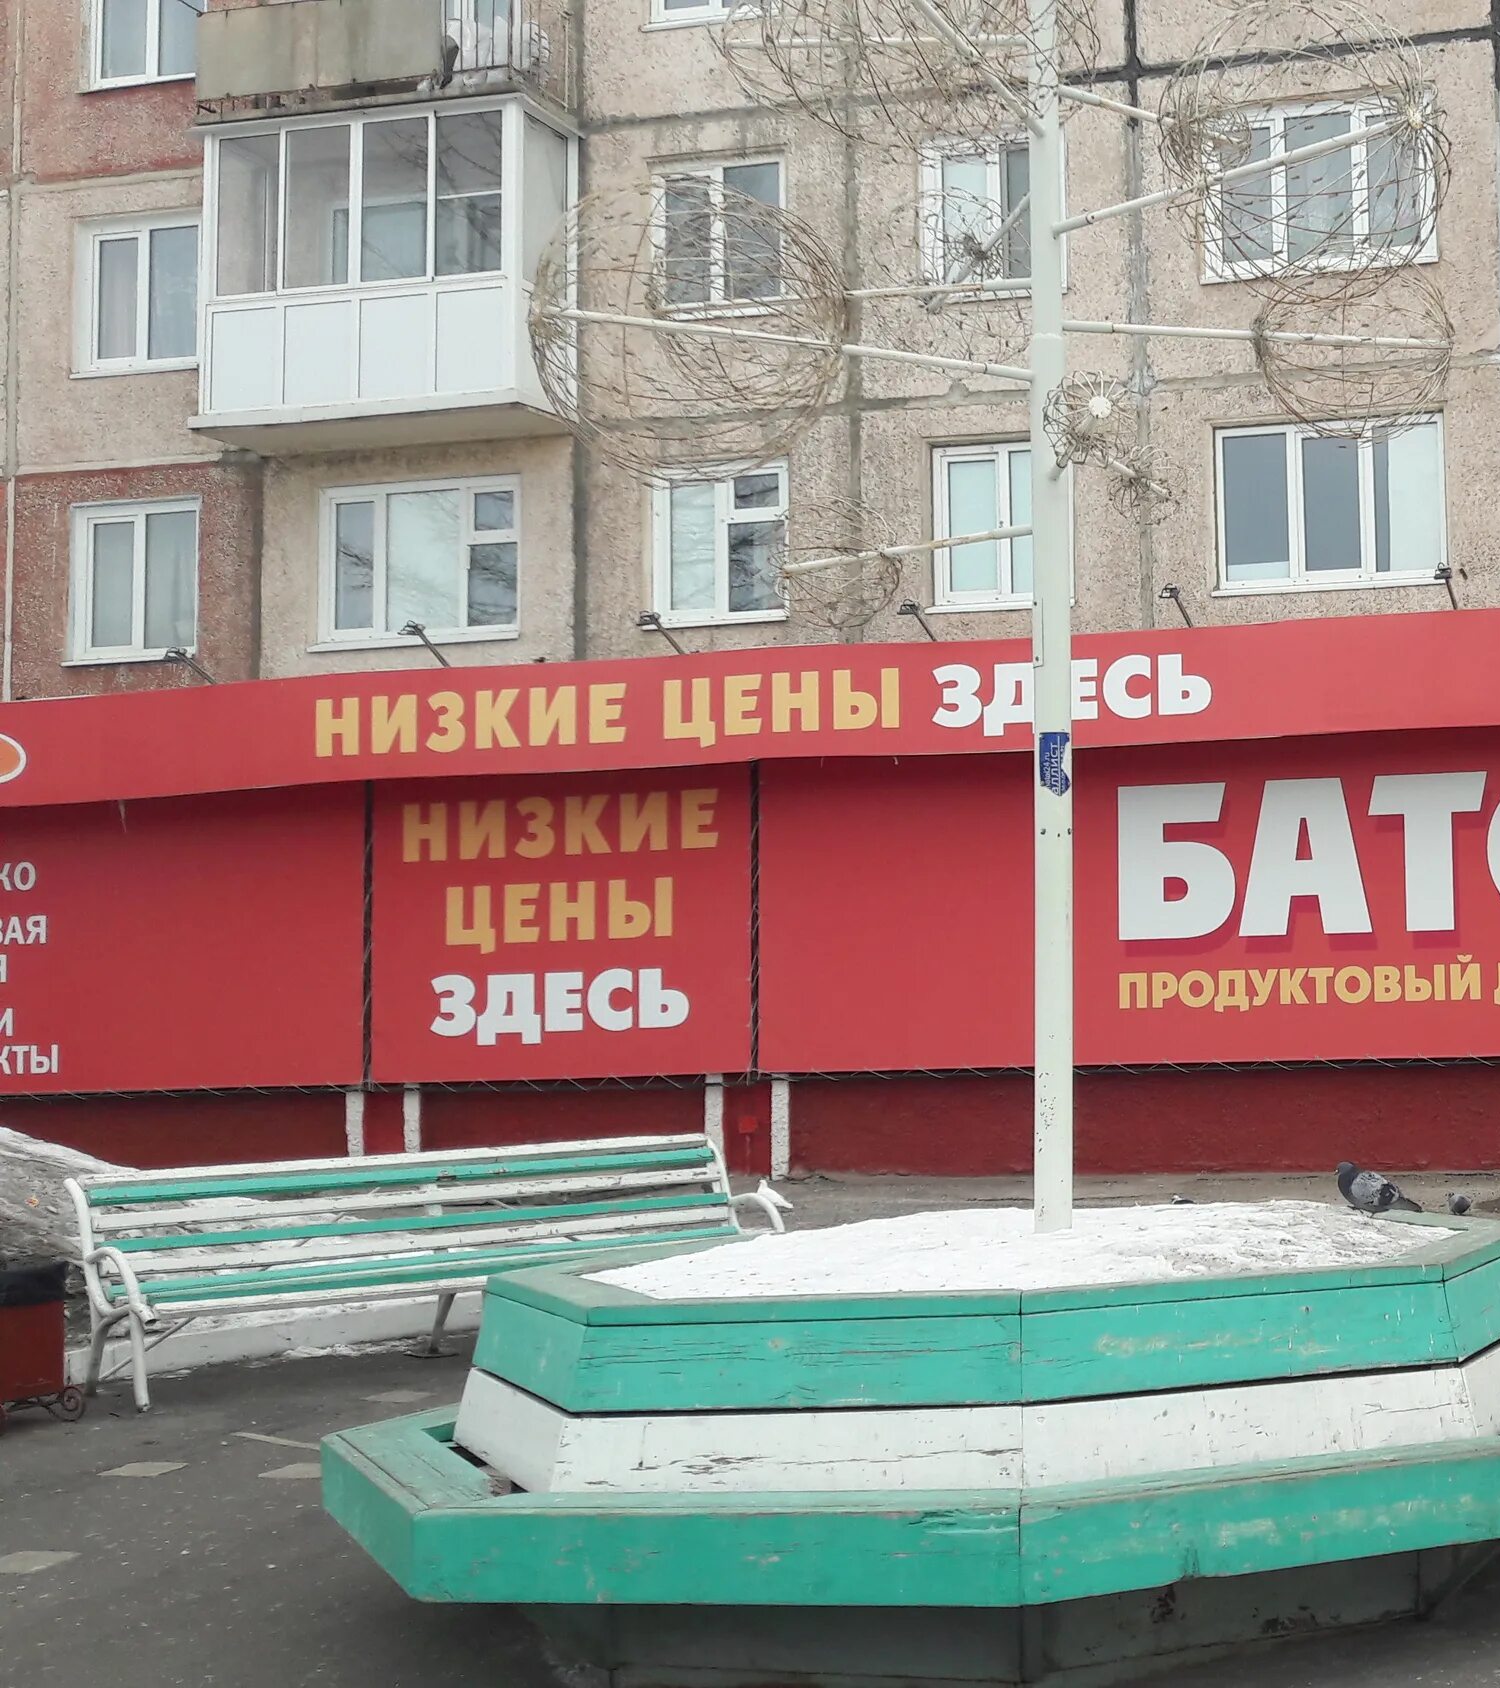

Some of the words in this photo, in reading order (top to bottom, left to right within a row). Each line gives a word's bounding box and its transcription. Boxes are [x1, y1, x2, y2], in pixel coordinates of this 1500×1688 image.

[316, 683, 627, 757] НИЗКИЕ
[663, 668, 900, 748] ЦЕНЫ
[932, 654, 1212, 736] ЗДЕСЬ
[403, 789, 719, 862] НИЗКИЕ
[0, 915, 47, 945] АЯ
[445, 877, 673, 954] ЦЕНЫ
[430, 968, 690, 1046] ЗДЕСЬ
[1118, 954, 1482, 1013] ПРОДУКТОВЫЙ
